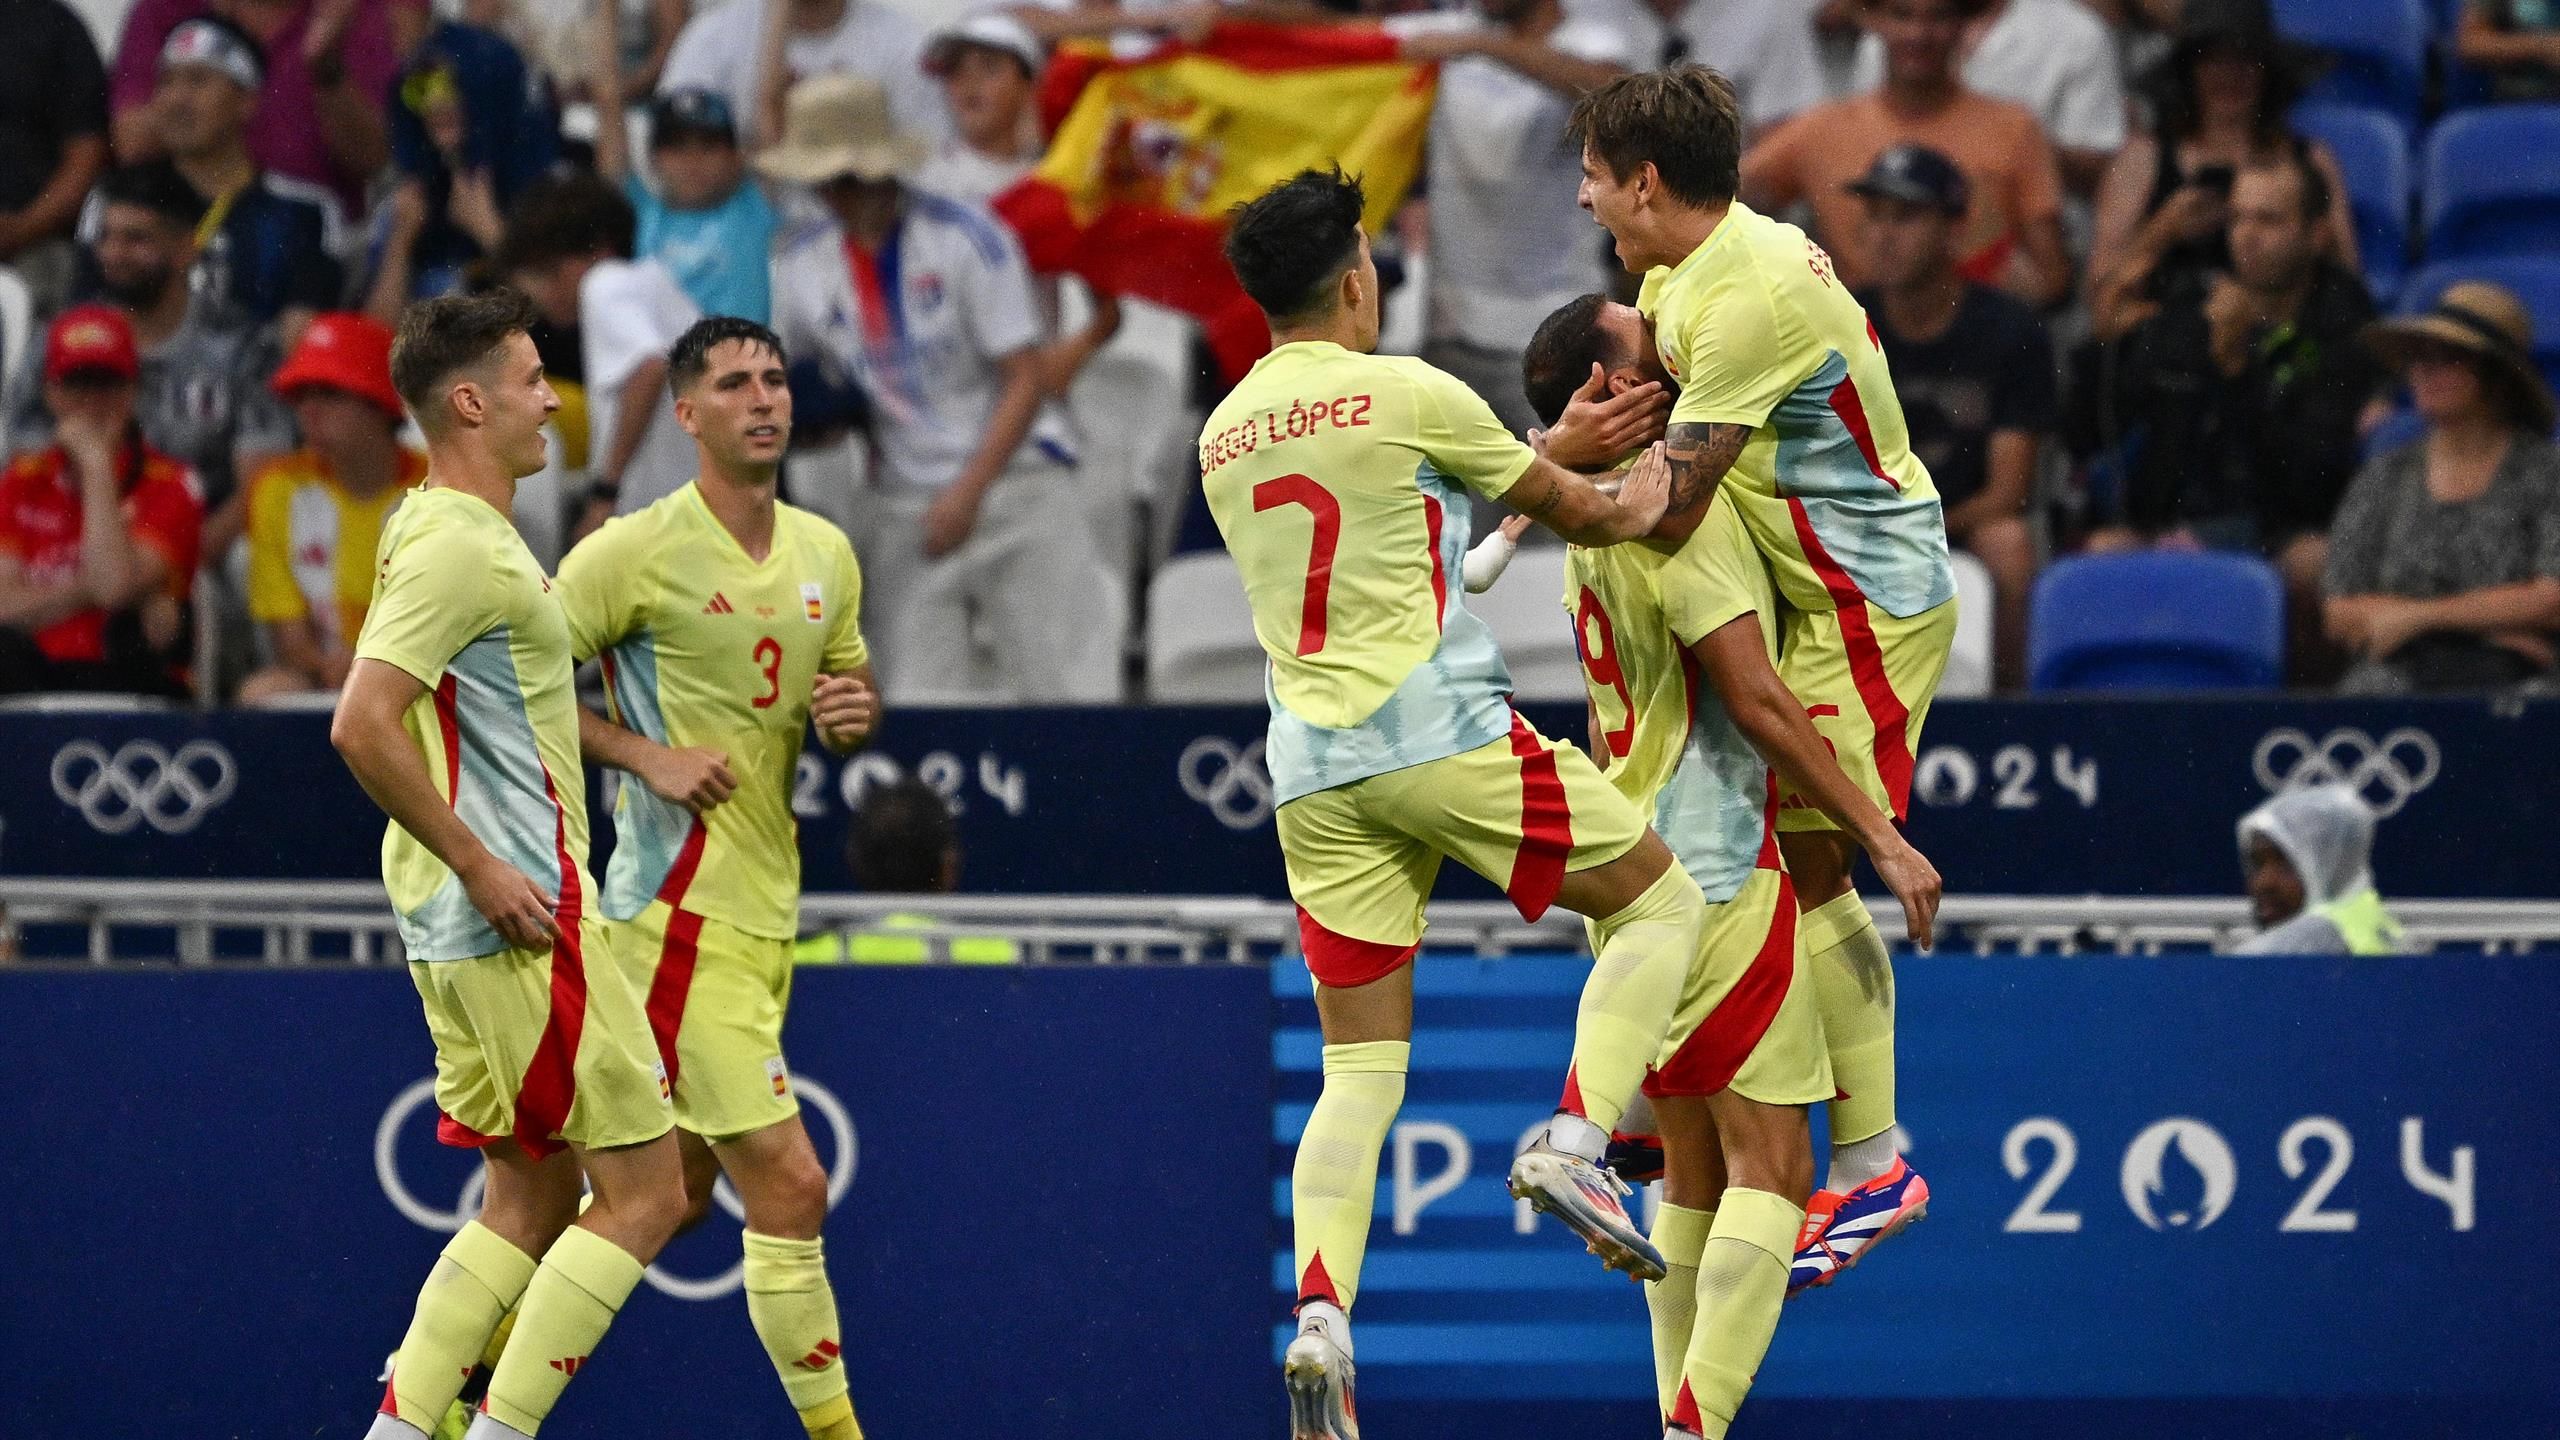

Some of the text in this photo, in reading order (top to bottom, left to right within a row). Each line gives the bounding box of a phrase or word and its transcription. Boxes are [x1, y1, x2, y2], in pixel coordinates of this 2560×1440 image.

[1201, 394, 1372, 477] DIEGO LÓPEZ
[1252, 473, 1341, 657] 7
[752, 636, 782, 709] 3
[1576, 583, 1635, 758] 9
[1913, 743, 2099, 808] 024
[2002, 1116, 2475, 1233] 2024
